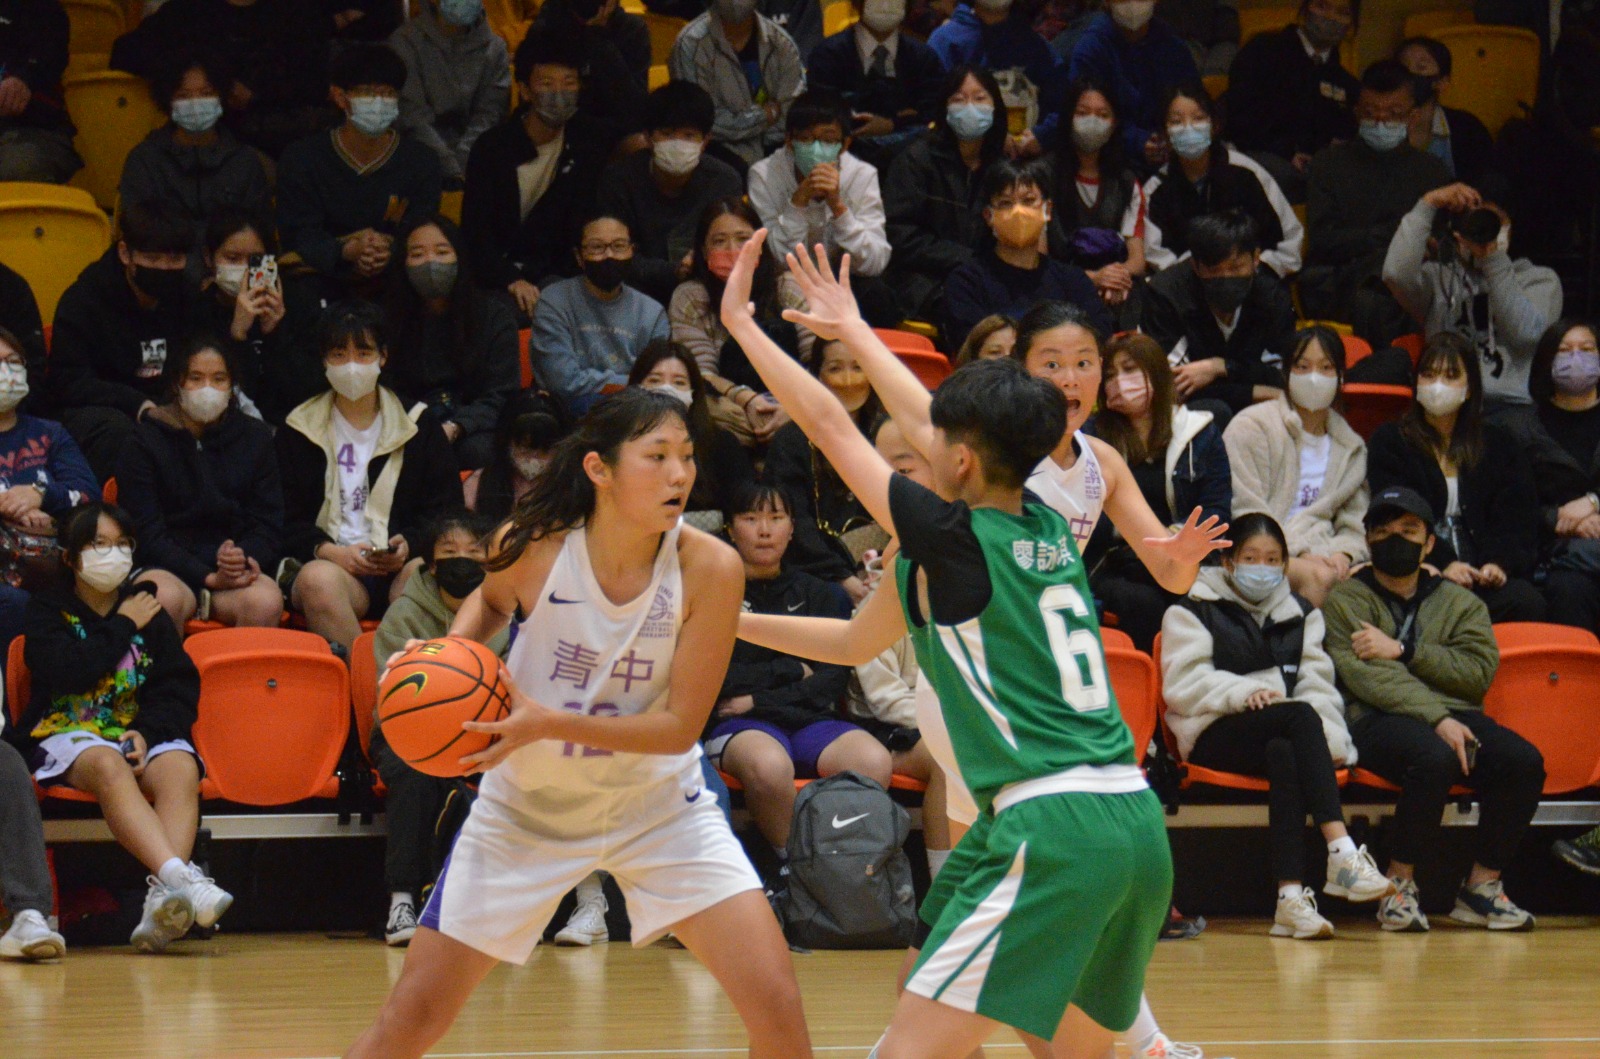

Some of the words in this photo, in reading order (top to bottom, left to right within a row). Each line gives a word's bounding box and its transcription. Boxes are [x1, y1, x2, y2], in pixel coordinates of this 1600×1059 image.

[337, 443, 356, 473] 4
[548, 638, 655, 693] 青中
[1038, 583, 1110, 713] 6
